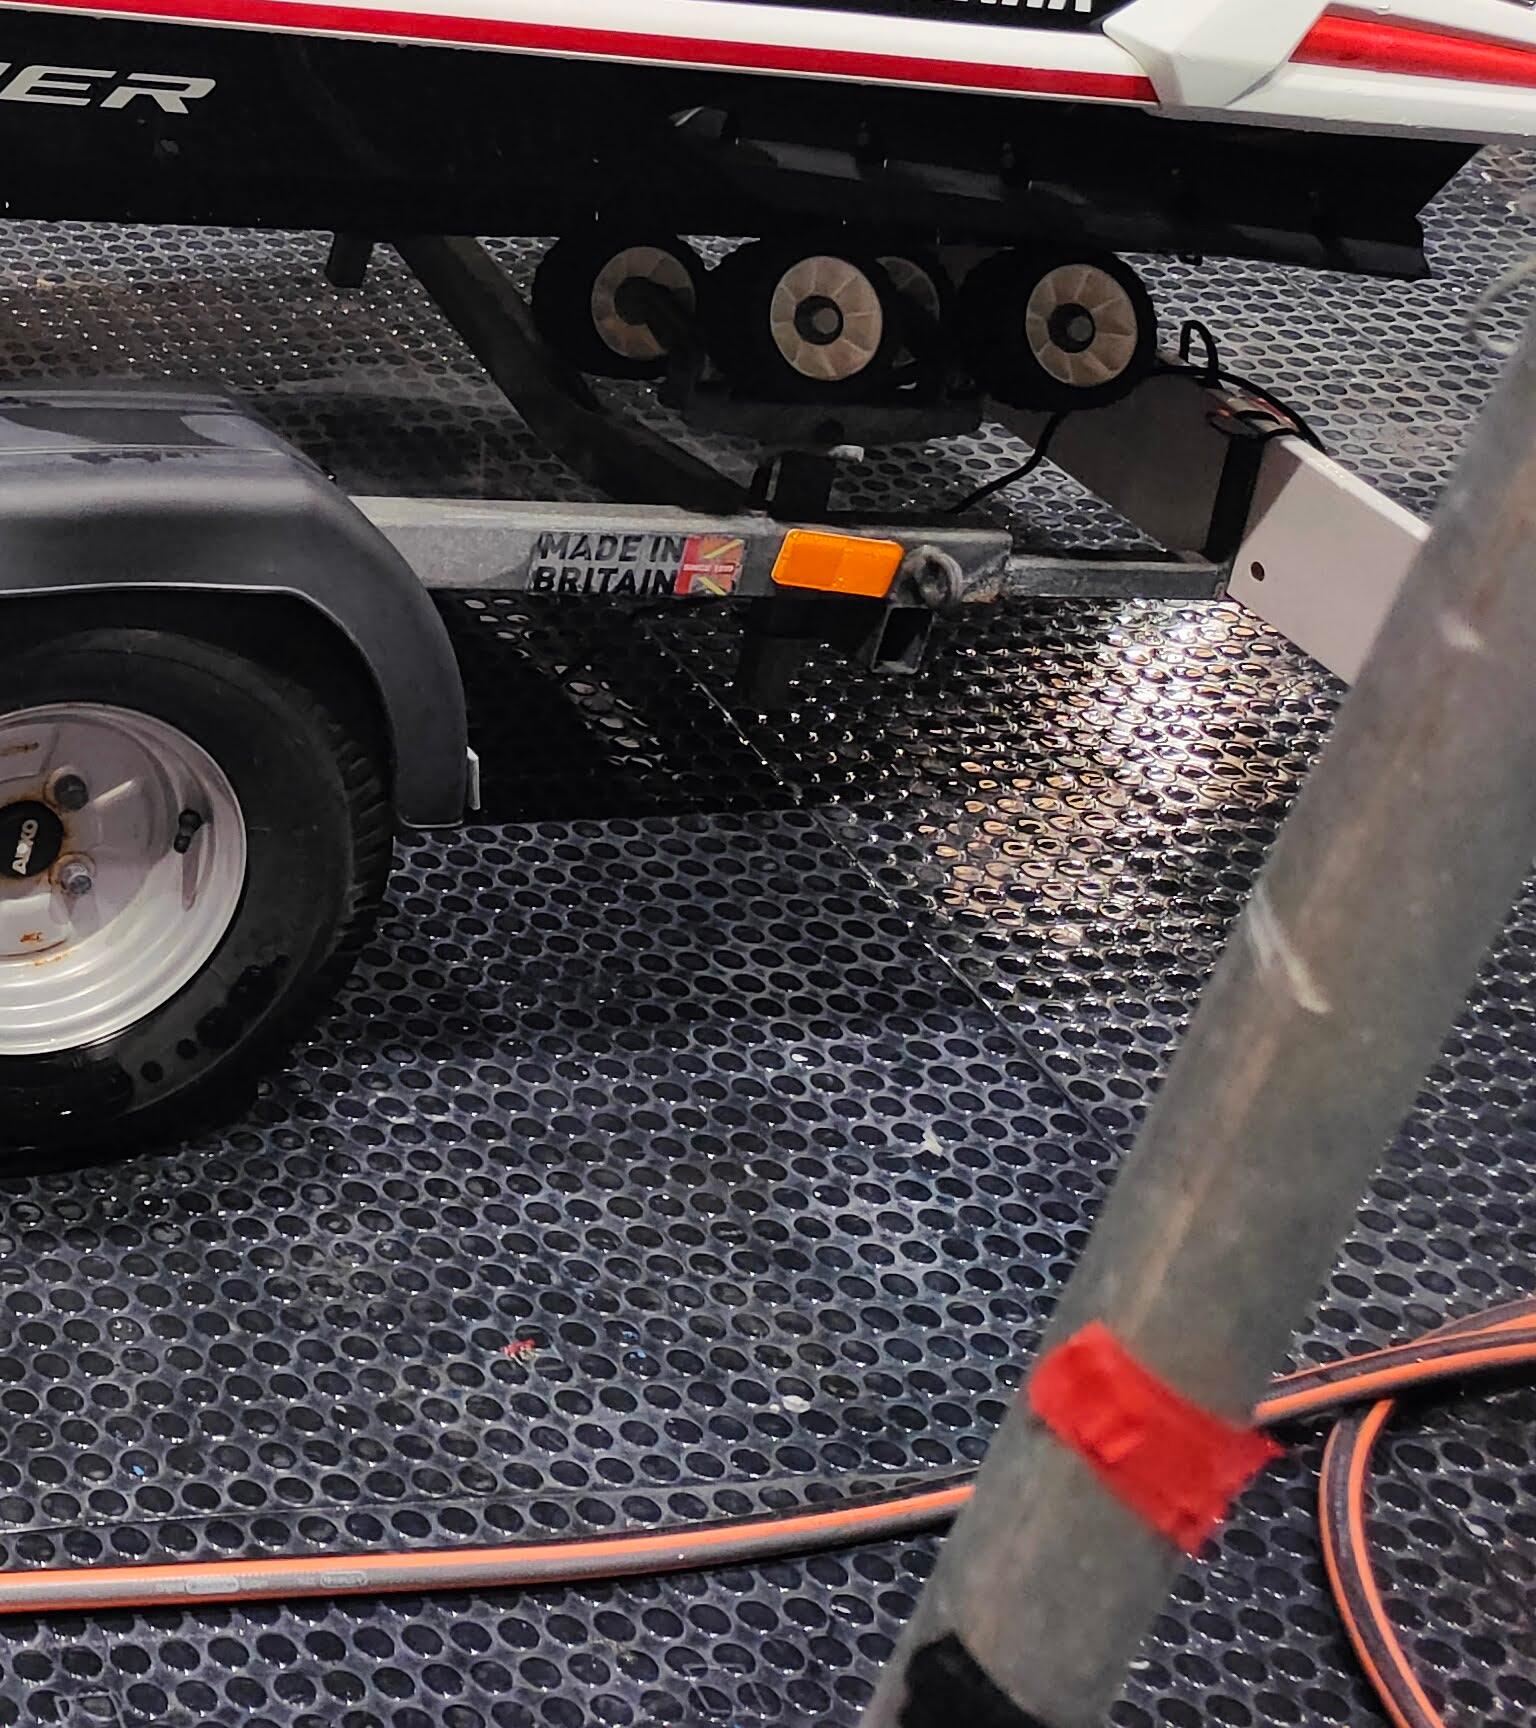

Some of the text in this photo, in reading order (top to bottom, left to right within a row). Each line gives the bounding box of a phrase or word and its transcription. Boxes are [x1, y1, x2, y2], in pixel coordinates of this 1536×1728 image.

[538, 531, 686, 564] MADE IN
[532, 566, 678, 595] BRITAIN
